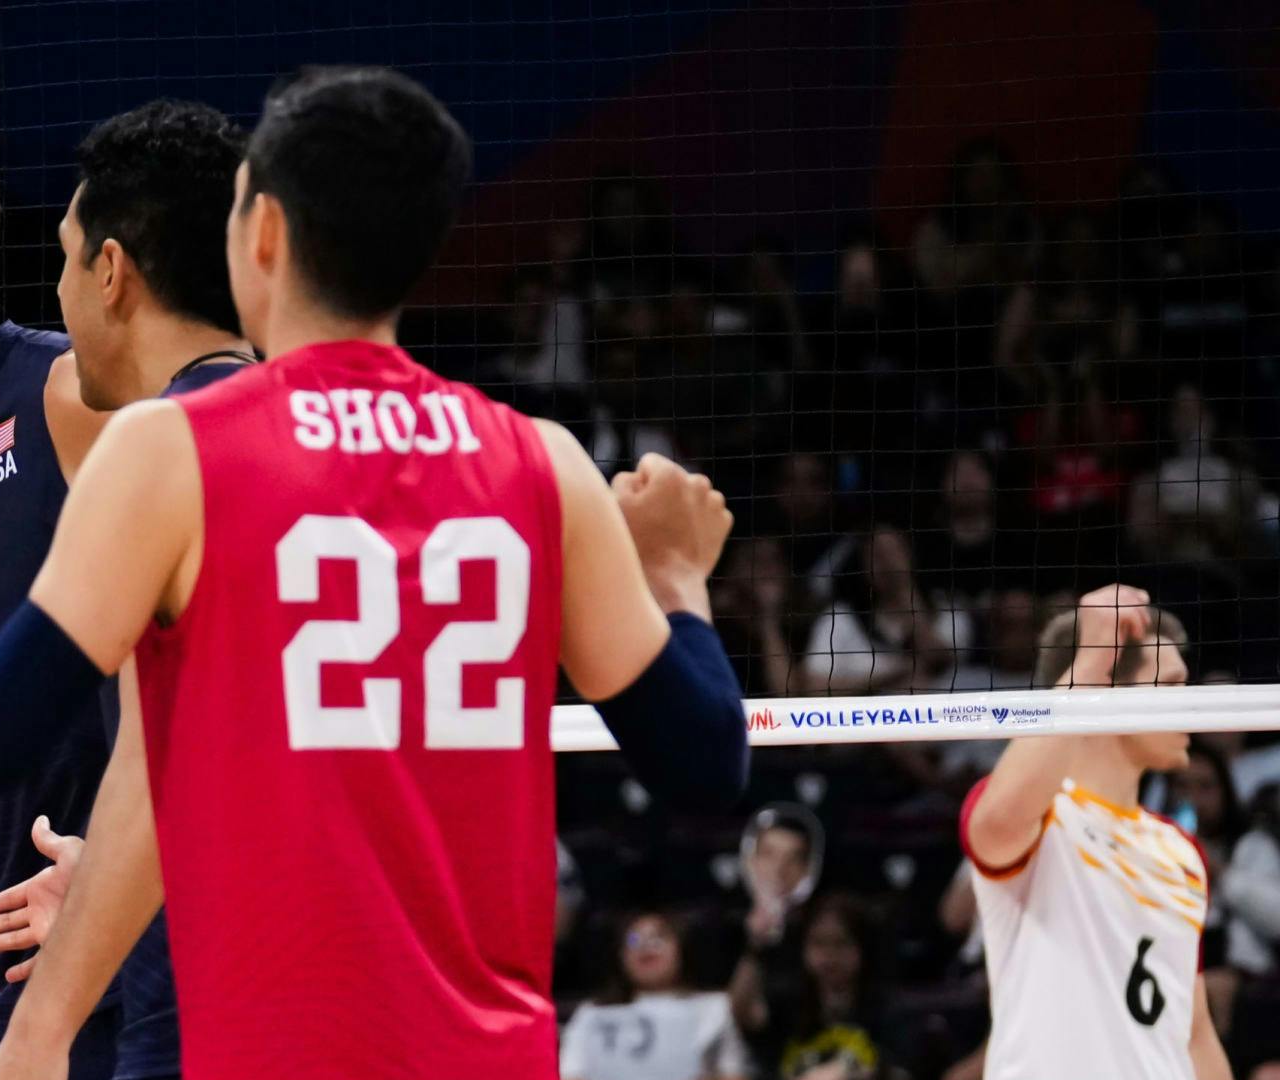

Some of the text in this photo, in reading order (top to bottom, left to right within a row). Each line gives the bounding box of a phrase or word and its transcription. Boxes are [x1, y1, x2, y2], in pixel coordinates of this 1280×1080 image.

[290, 388, 481, 455] SHOJI
[275, 514, 531, 751] 22
[790, 707, 939, 729] VOLLEYBALL
[943, 705, 987, 714] NATIONS
[1011, 708, 1051, 717] Volleyball
[1126, 936, 1166, 1026] 6
